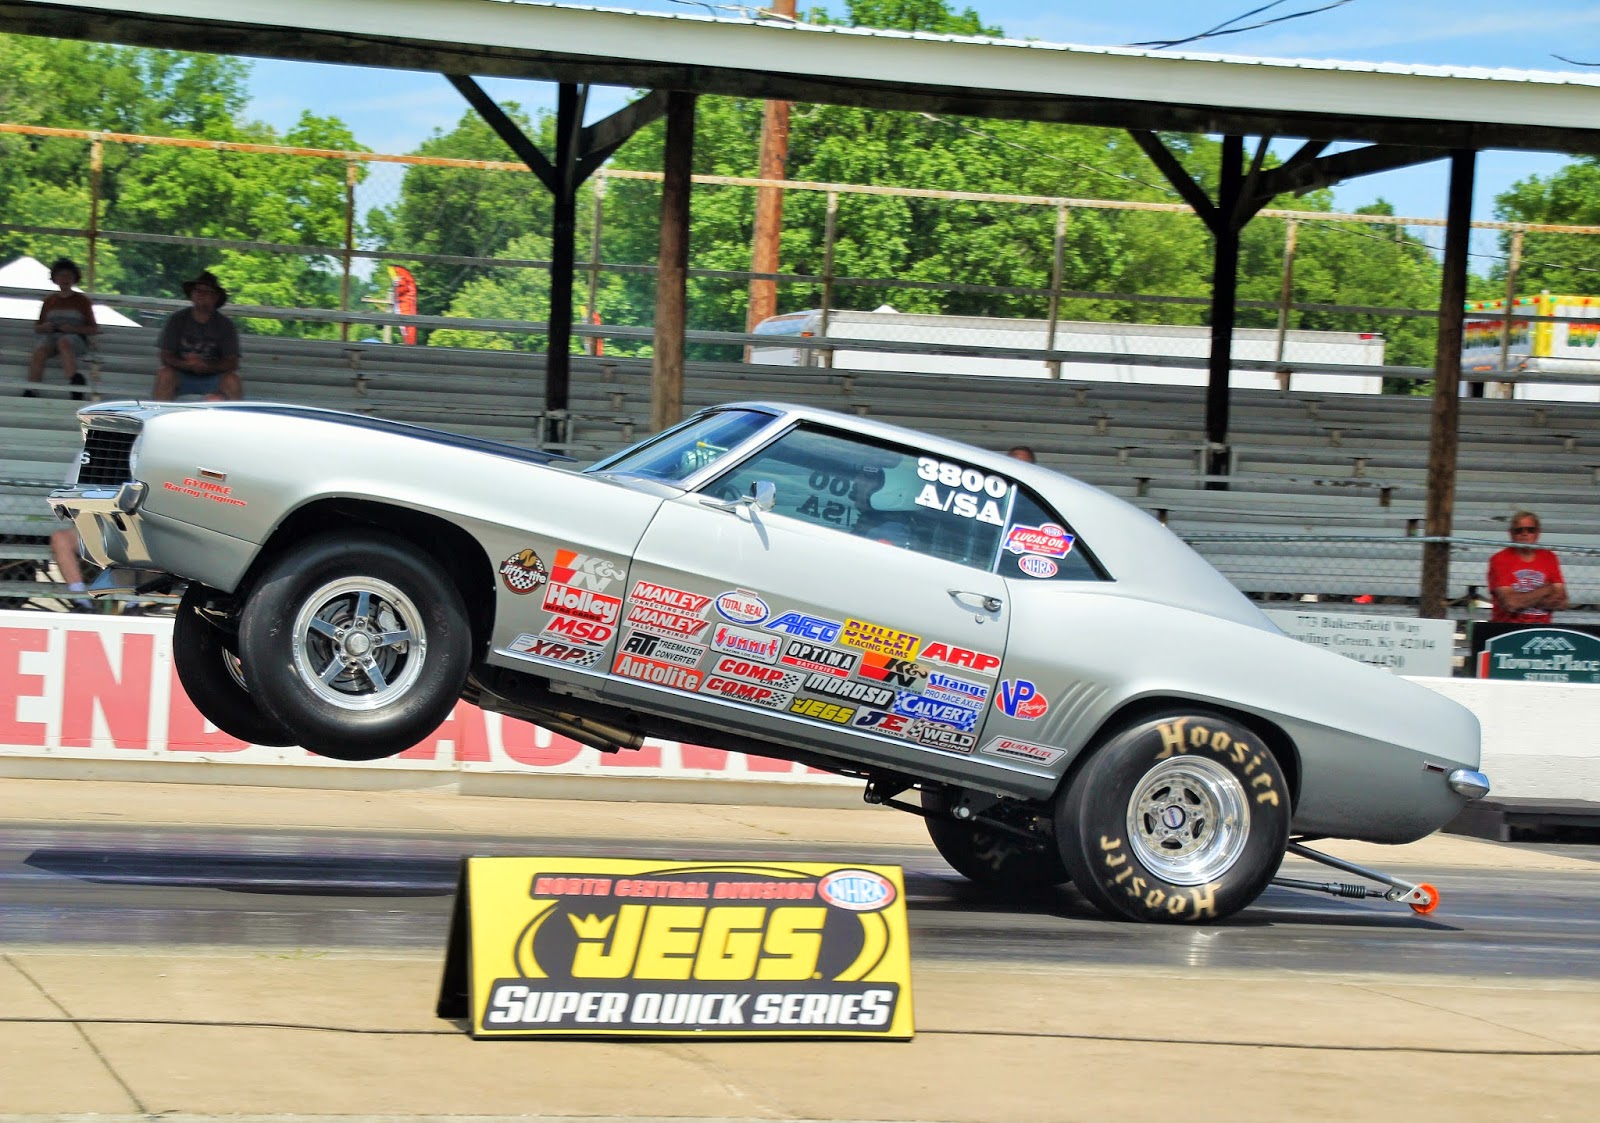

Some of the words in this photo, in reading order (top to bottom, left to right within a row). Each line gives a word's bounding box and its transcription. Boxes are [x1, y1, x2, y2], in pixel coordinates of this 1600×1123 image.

[917, 457, 1007, 498] 3800
[163, 481, 201, 498] Racing
[203, 492, 247, 506] Engines
[914, 484, 1004, 526] A/SA
[1013, 532, 1048, 544] LUCAS
[1048, 538, 1064, 548] OIL
[500, 564, 546, 584] Jiffy-tite
[1025, 559, 1051, 573] NHRA
[547, 584, 618, 623] Holley
[629, 598, 677, 613] CONNECTING
[680, 610, 700, 618] RODS
[633, 584, 703, 610] MANLEY
[722, 598, 742, 612] TOTAL
[744, 604, 763, 618] SEAL
[547, 616, 612, 642] MSD
[630, 607, 700, 632] MANLEY
[764, 613, 842, 642] AFCO
[631, 622, 653, 632] VALVE
[656, 628, 689, 640] SPRINGS
[845, 621, 918, 652] BULLET
[525, 640, 586, 660] XRP
[655, 650, 696, 665] CONVERTER
[658, 640, 704, 656] TREEMASTER
[788, 643, 854, 669] OPTIMA
[848, 638, 880, 652] RACING
[884, 647, 909, 659] CAMS
[921, 642, 1000, 670] ARP
[616, 656, 698, 690] Autolite
[718, 659, 784, 681] COMP
[796, 661, 836, 674] BATTERIES
[706, 678, 772, 700] COMP
[760, 679, 791, 690] CAMS
[805, 674, 894, 706] MOROSO
[930, 673, 987, 698] Strange
[721, 691, 753, 702] ROCKER
[754, 698, 778, 708] ARMS
[901, 696, 974, 723] CALVERT
[924, 690, 940, 700] PRO
[941, 693, 960, 704] RACE
[962, 698, 984, 710] AXLES
[1002, 680, 1035, 717] VP
[1018, 702, 1048, 714] Racing
[790, 699, 856, 724] JEGS
[856, 711, 909, 732] JE
[869, 726, 905, 738] PISTONS
[924, 728, 974, 746] WELD
[921, 739, 970, 752] RACING
[1155, 717, 1279, 807] Hoosier
[534, 878, 612, 896] NORTH
[614, 879, 709, 899] CENTRAL
[712, 882, 817, 900] DIVISION
[828, 878, 887, 904] NHRA
[571, 904, 828, 980] JEGS
[488, 986, 630, 1022] SUPER
[630, 993, 752, 1024] QUICK
[752, 990, 894, 1026] SERIES
